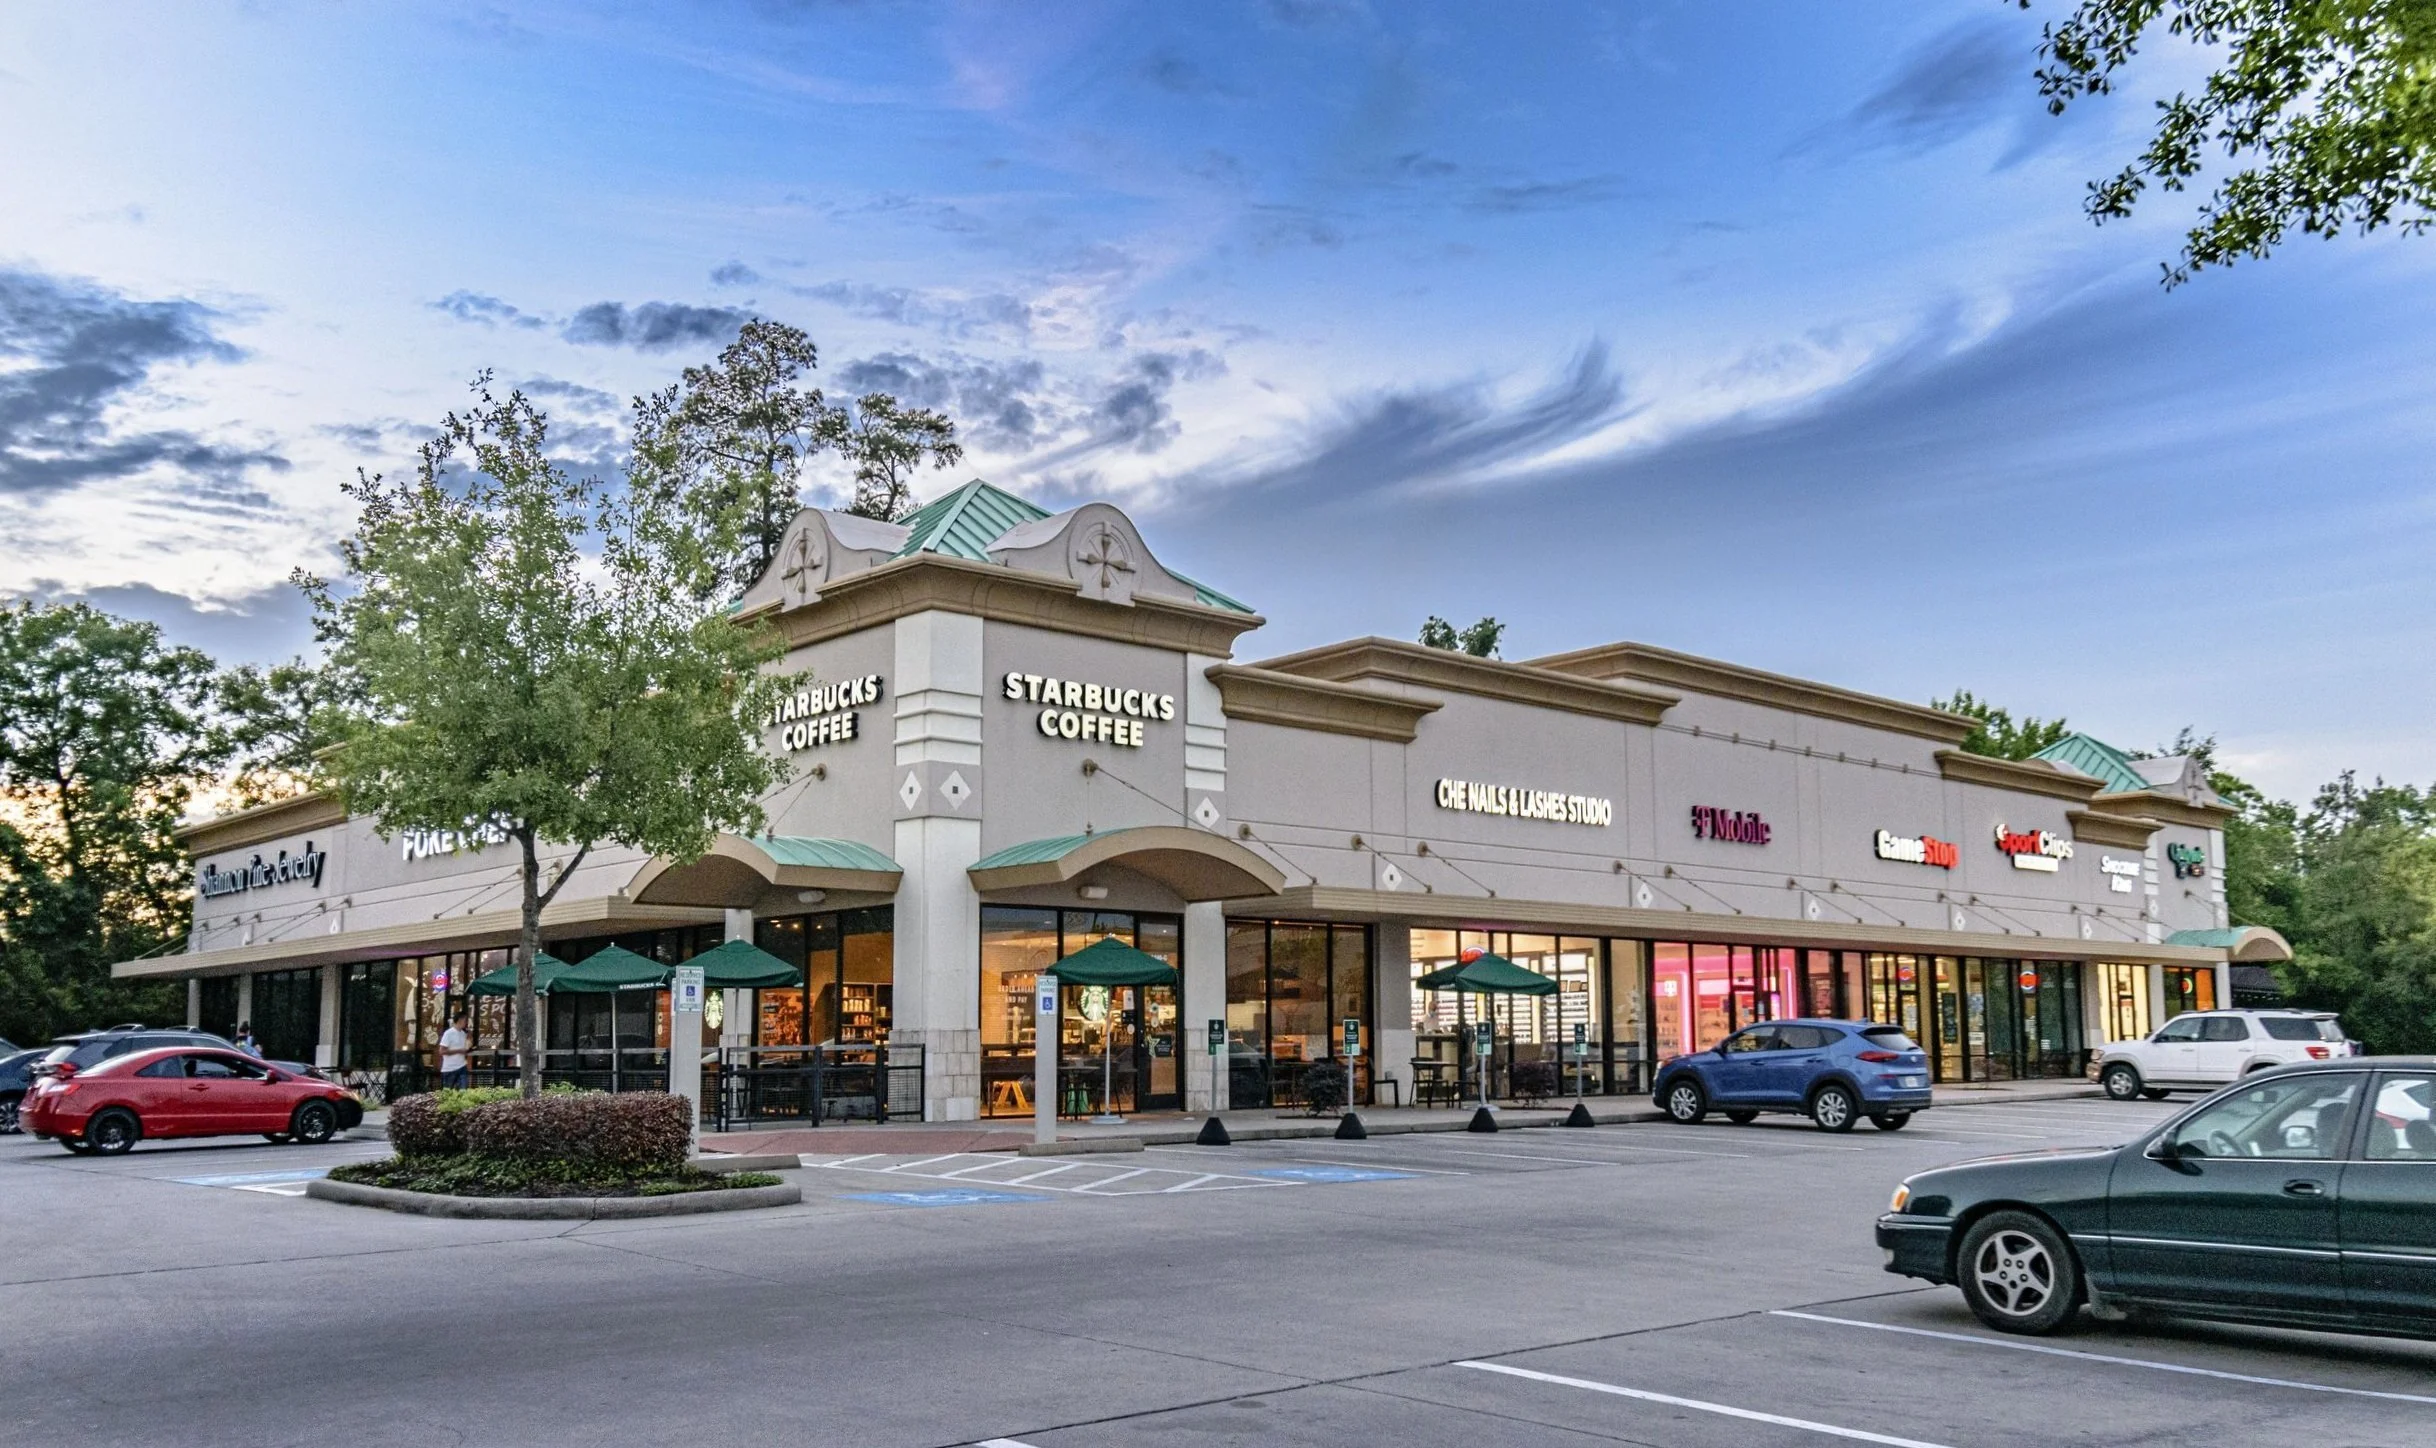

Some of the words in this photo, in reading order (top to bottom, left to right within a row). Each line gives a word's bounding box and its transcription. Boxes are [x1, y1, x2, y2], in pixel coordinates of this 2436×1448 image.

[1003, 671, 1175, 721] STARBUCKS
[781, 711, 857, 751] COFFEE
[1038, 708, 1144, 747] COFFEE
[1436, 777, 1466, 810] CHE
[1468, 782, 1507, 815] NAILS
[1508, 787, 1519, 816] &
[1519, 788, 1567, 822] LASHES
[1568, 795, 1612, 826] STUDIO
[201, 864, 246, 898] Shannon
[248, 854, 275, 887] Fine
[272, 841, 326, 888] Jewelry
[1876, 829, 1960, 869] GameStop
